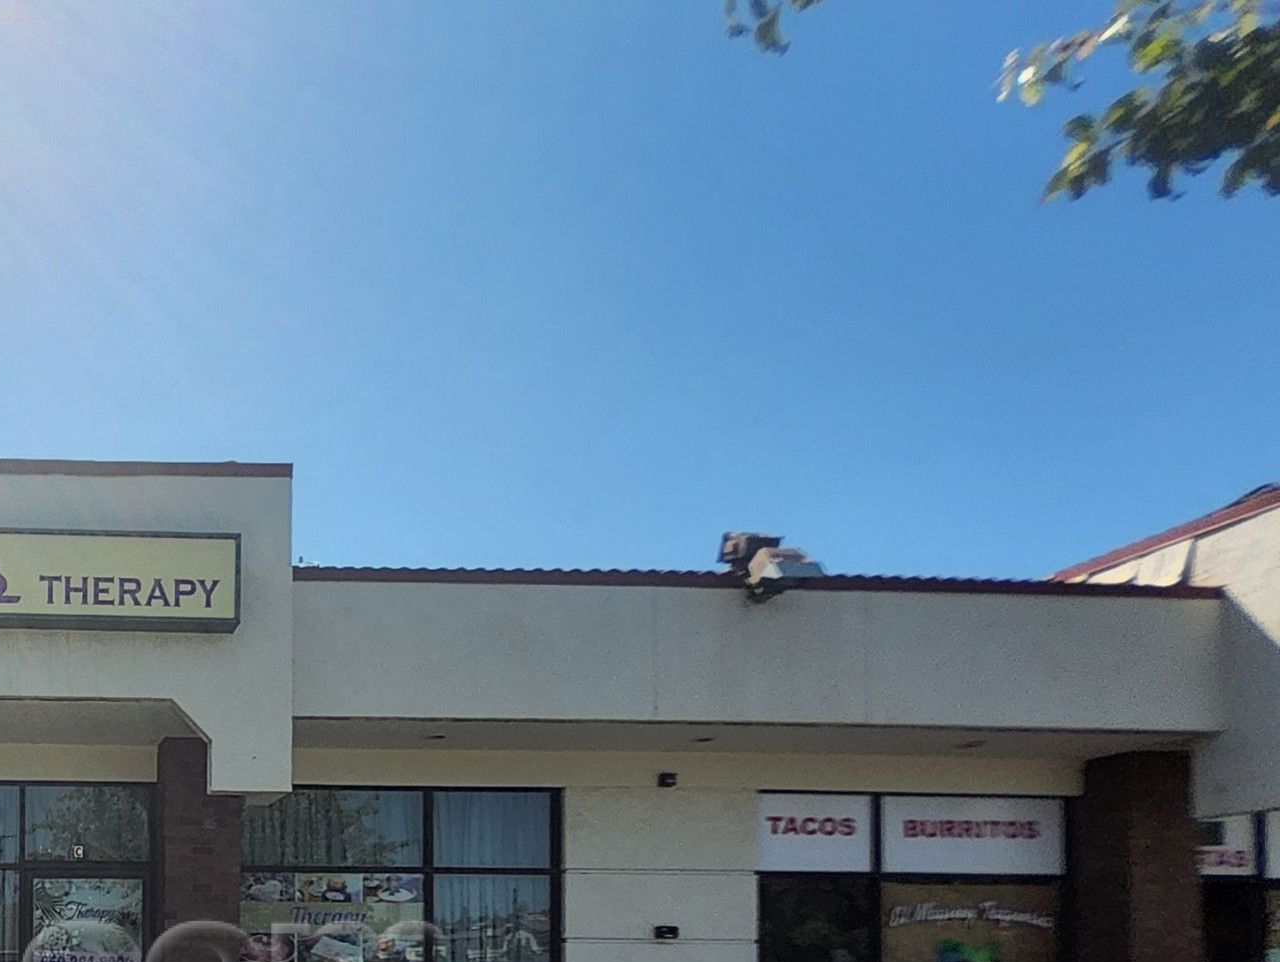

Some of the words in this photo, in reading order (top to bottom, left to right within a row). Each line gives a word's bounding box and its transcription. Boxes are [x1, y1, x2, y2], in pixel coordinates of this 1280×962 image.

[39, 574, 221, 609] THERAPY
[765, 816, 858, 836] TACOS
[903, 818, 1041, 839] BURRITOS
